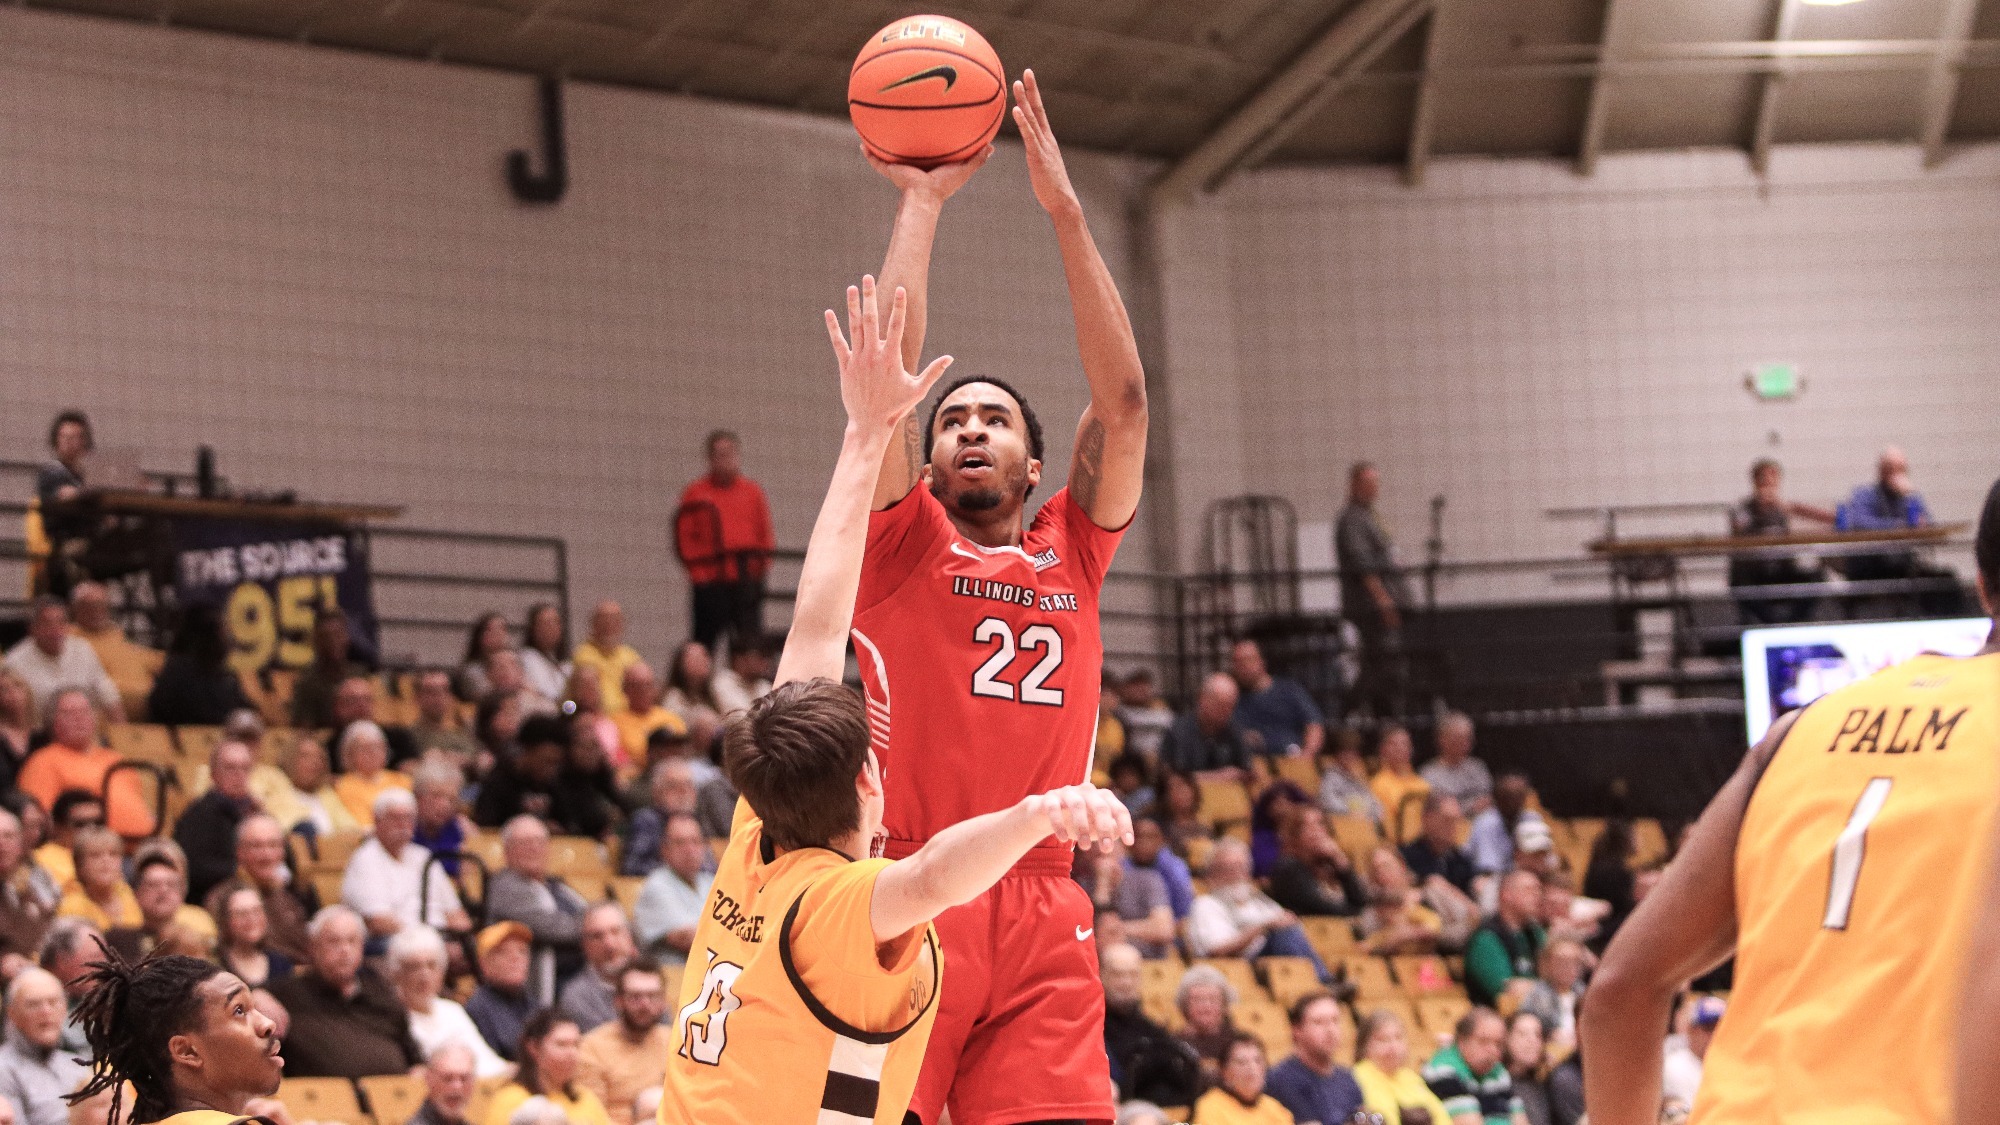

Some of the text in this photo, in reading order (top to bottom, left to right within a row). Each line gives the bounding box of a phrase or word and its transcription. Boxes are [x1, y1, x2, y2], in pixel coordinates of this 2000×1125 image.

[504, 76, 568, 206] J
[179, 535, 347, 587] THE SOURCE
[953, 575, 1078, 612] ILLINOIS STATE
[971, 615, 1064, 708] 22
[1827, 706, 1970, 754] PALM
[1823, 776, 1894, 931] 1
[678, 947, 744, 1066] 13
